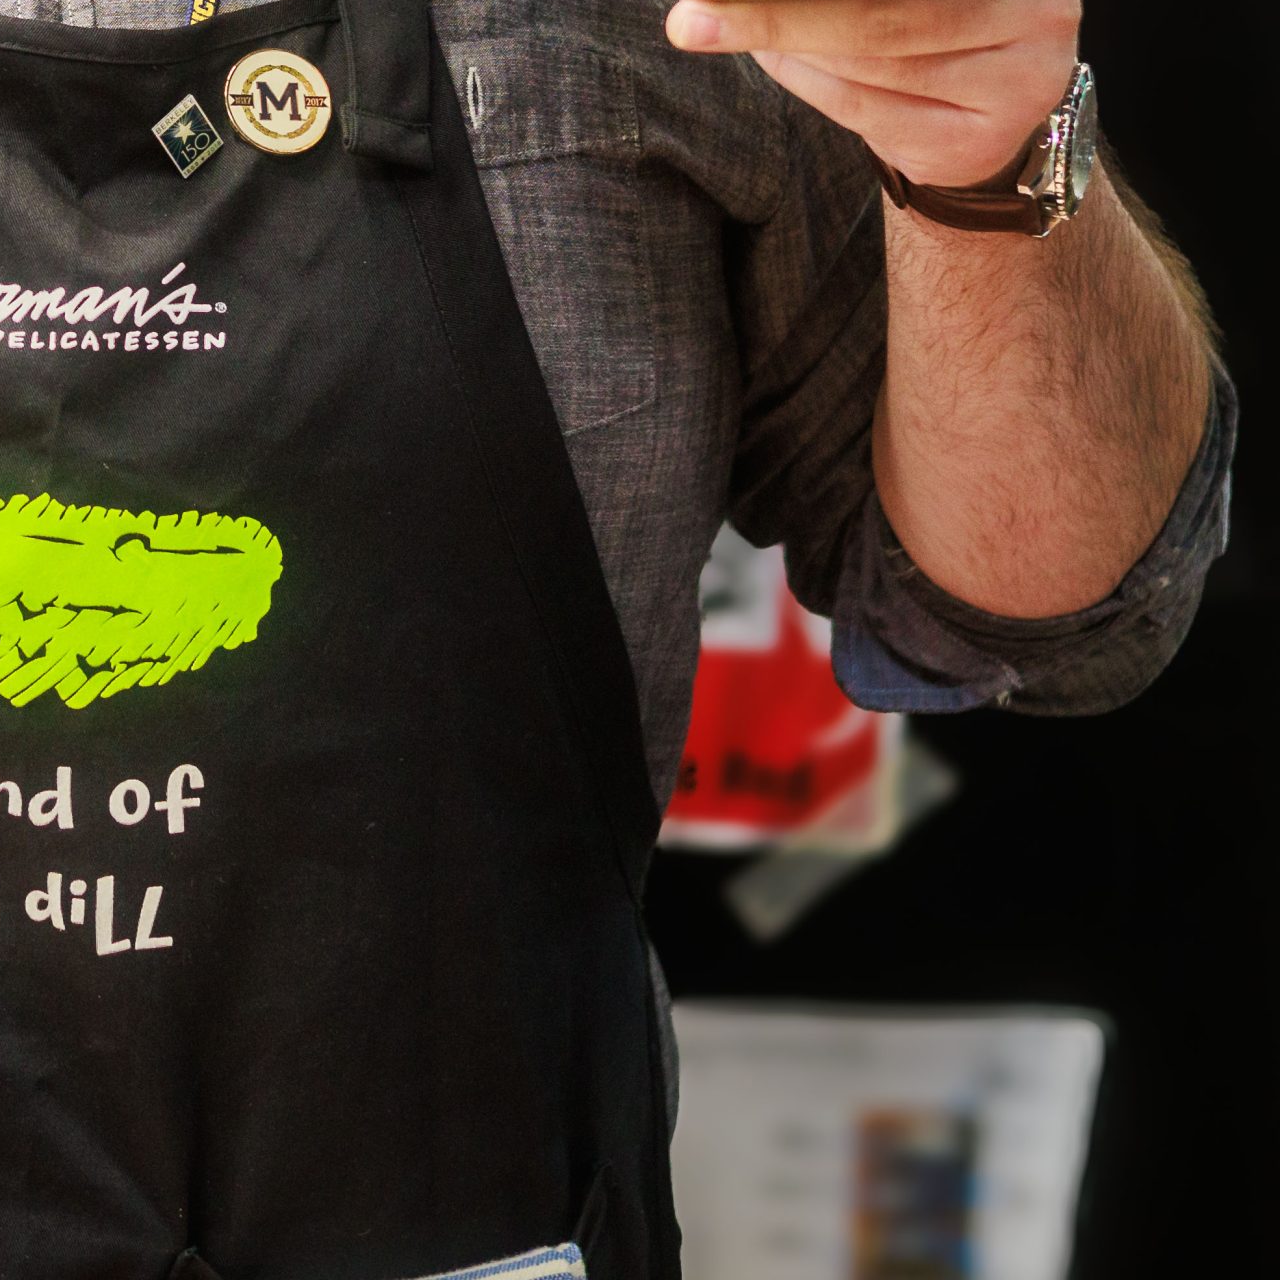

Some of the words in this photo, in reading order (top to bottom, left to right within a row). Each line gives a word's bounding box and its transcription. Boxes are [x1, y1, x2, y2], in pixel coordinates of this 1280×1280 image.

[155, 98, 194, 135] BERKELEY
[256, 81, 302, 121] M
[306, 97, 325, 107] 2017
[181, 132, 211, 163] 150
[109, 763, 205, 834] of
